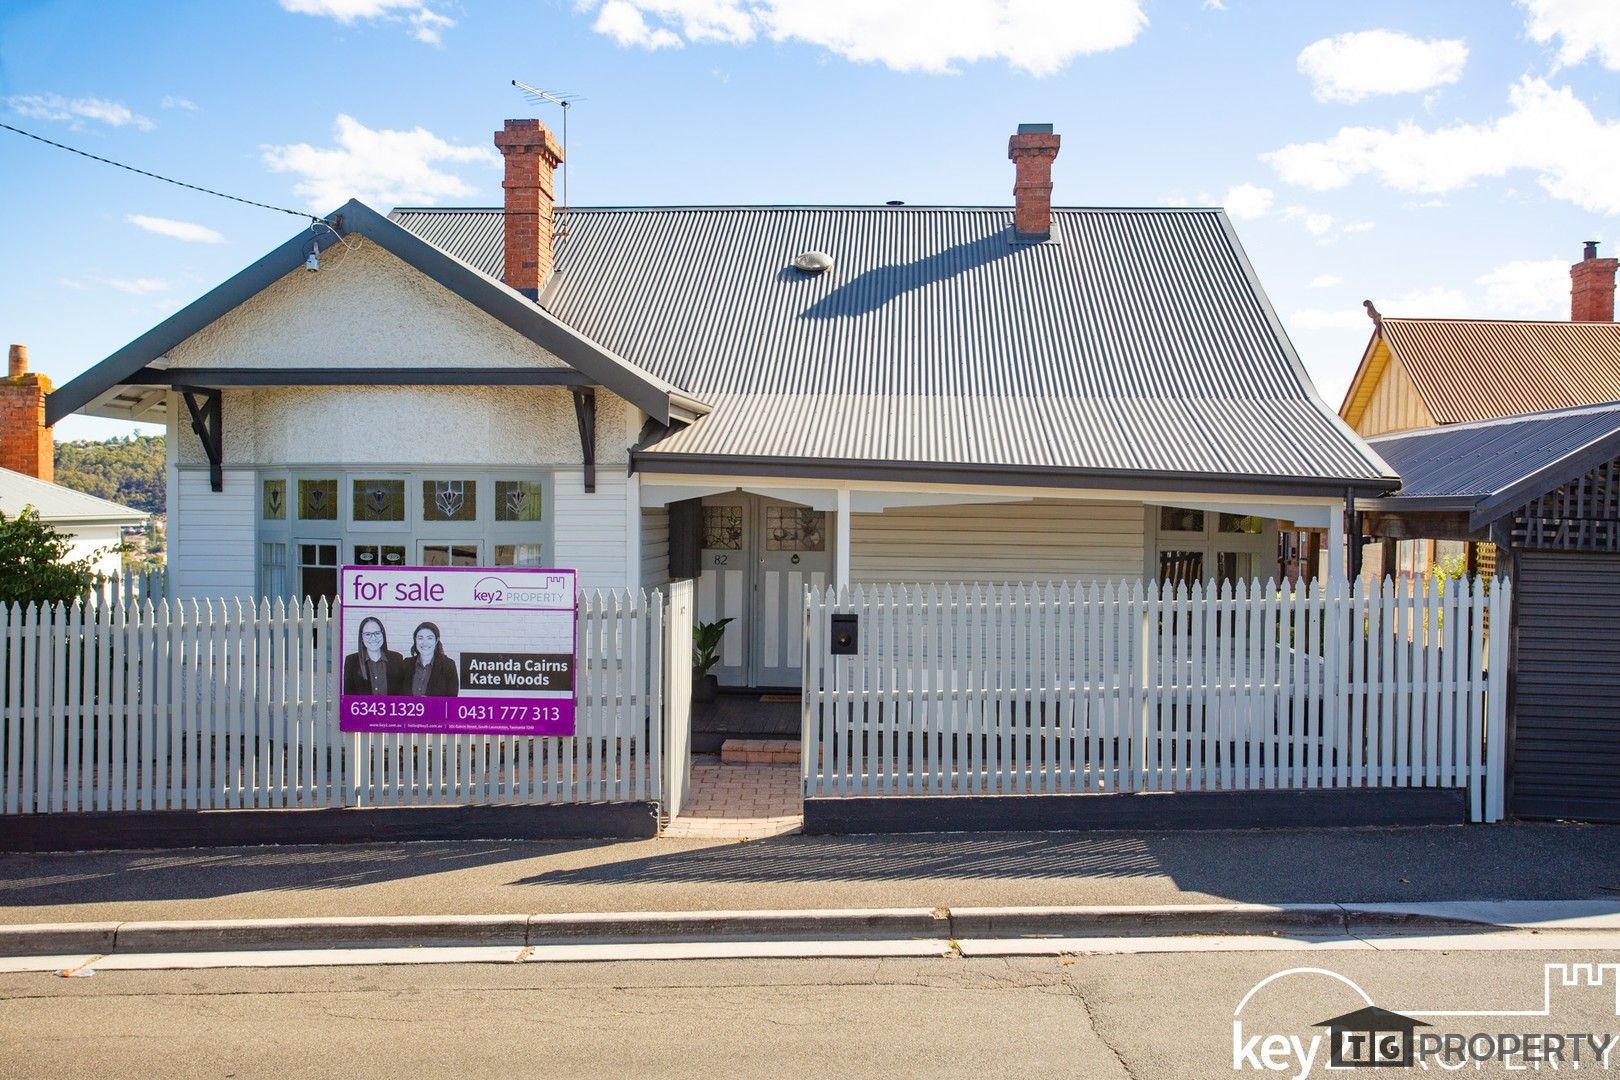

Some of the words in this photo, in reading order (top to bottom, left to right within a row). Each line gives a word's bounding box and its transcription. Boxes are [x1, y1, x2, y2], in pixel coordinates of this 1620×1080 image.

[714, 555, 728, 566] 82
[353, 574, 388, 601] for
[395, 576, 445, 602] sale
[474, 588, 503, 604] key2
[506, 592, 565, 602] PROPERTY
[469, 658, 521, 671] Ananda
[524, 659, 568, 672] Cairns
[469, 672, 502, 685] Kate
[504, 673, 550, 686] Woods
[350, 701, 386, 717] 6343
[389, 702, 425, 717] 1329
[458, 705, 494, 720] 0431
[500, 706, 528, 720] 777
[532, 706, 560, 721] 313
